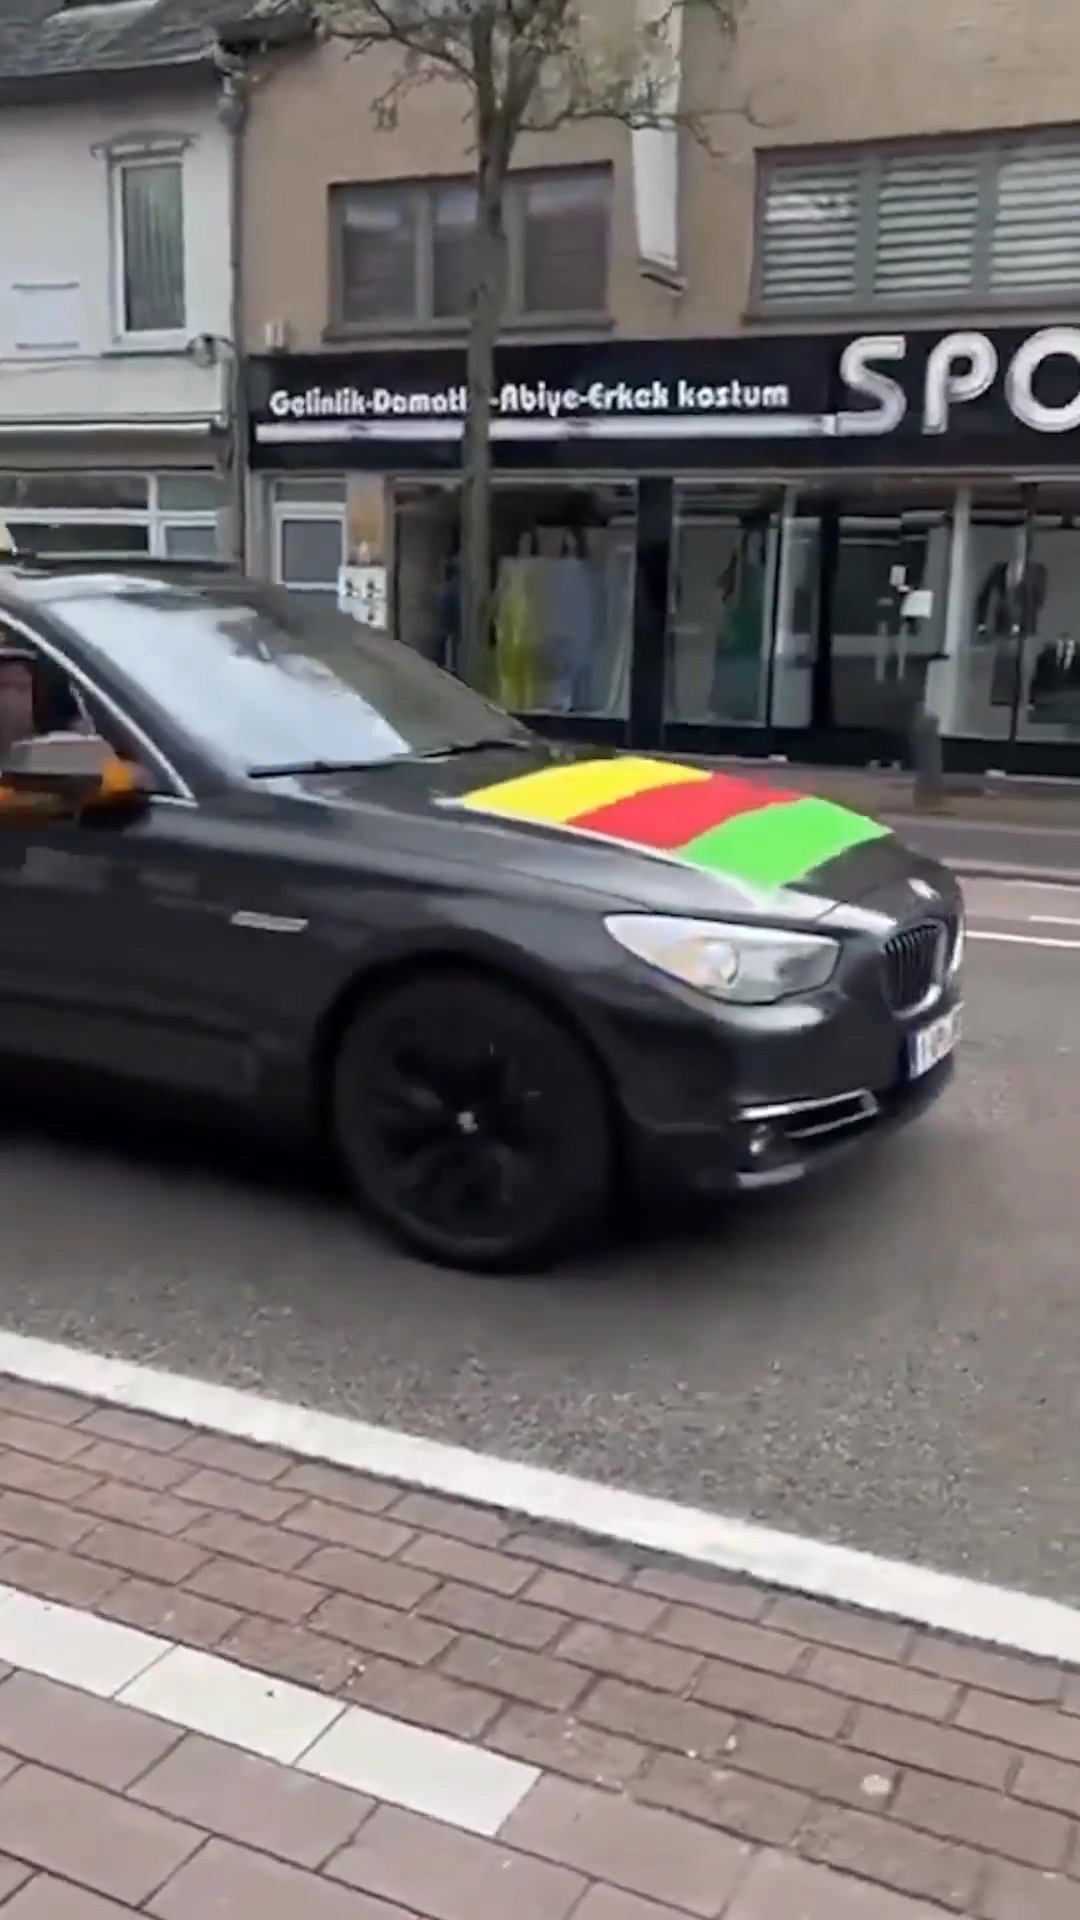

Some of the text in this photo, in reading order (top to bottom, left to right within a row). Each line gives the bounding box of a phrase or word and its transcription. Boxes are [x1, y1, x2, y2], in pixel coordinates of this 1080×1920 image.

[269, 379, 789, 417] Gelinlik-Damatl-Abiye-Erkek kostum
[838, 326, 1080, 435] SPO
